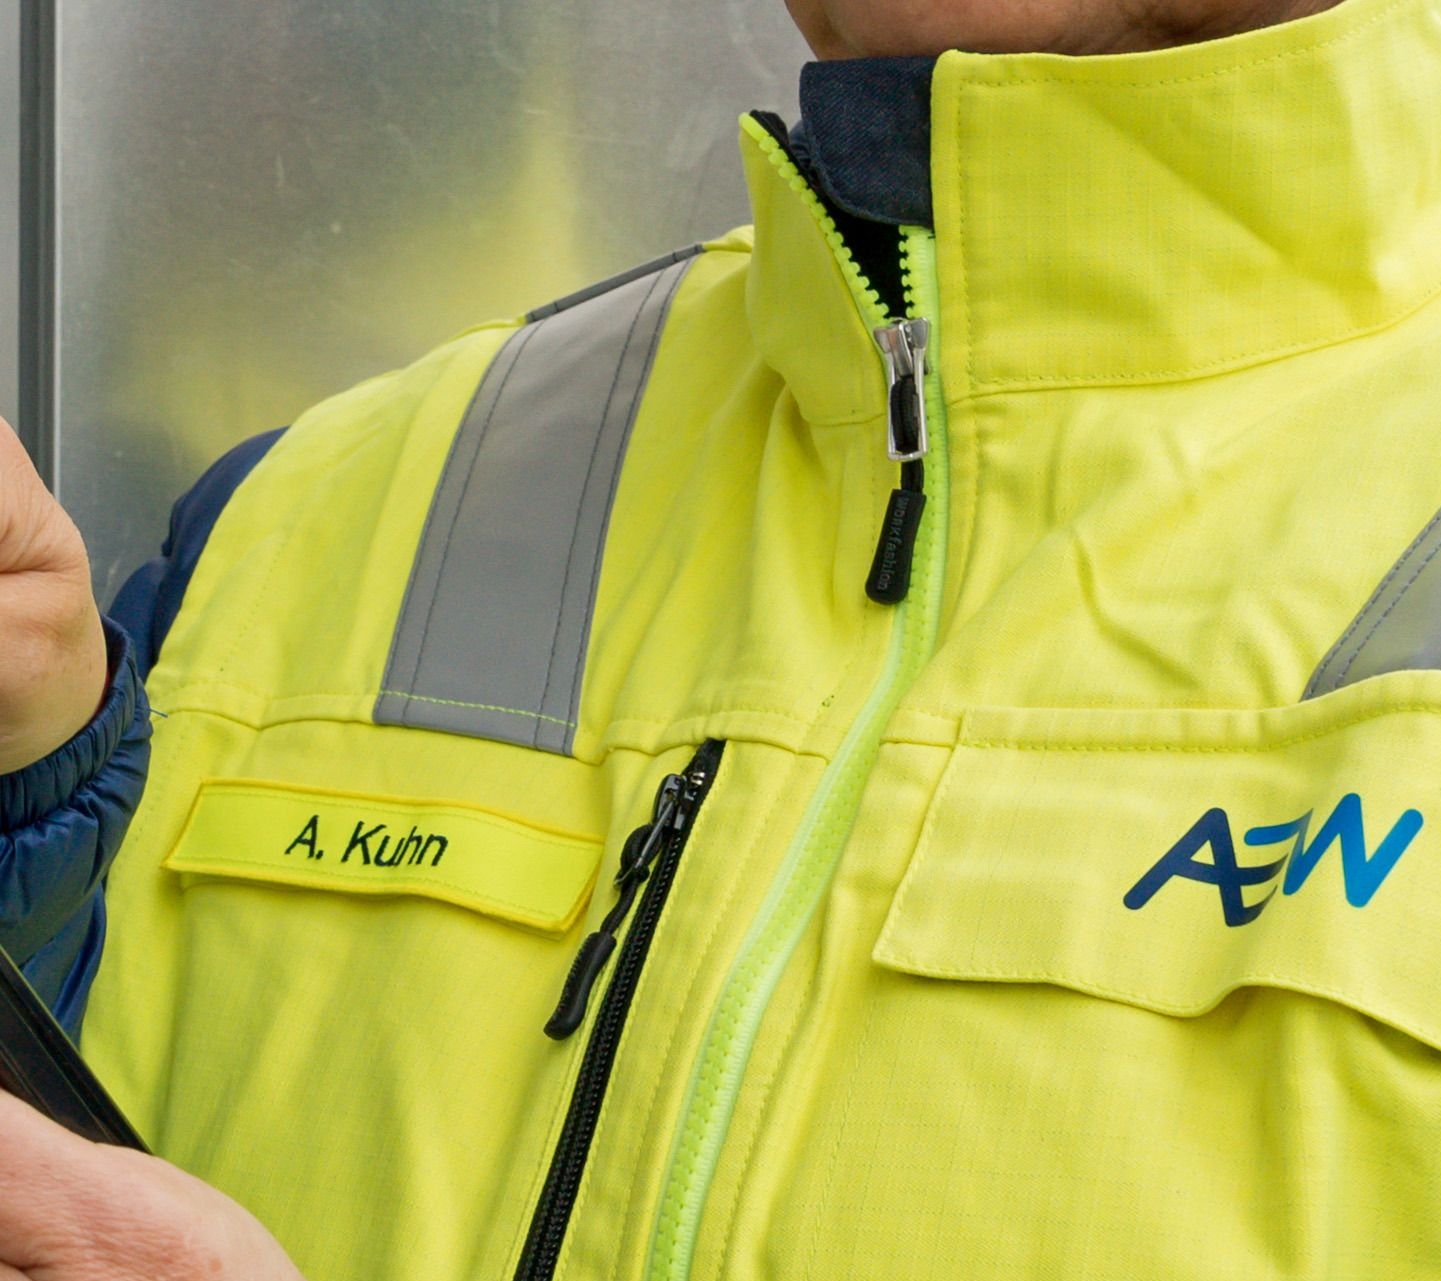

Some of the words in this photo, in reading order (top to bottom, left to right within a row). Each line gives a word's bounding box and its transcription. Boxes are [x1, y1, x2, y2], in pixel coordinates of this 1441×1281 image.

[284, 814, 324, 860] A.
[340, 820, 449, 867] Kuhn
[1123, 792, 1425, 928] AEW
